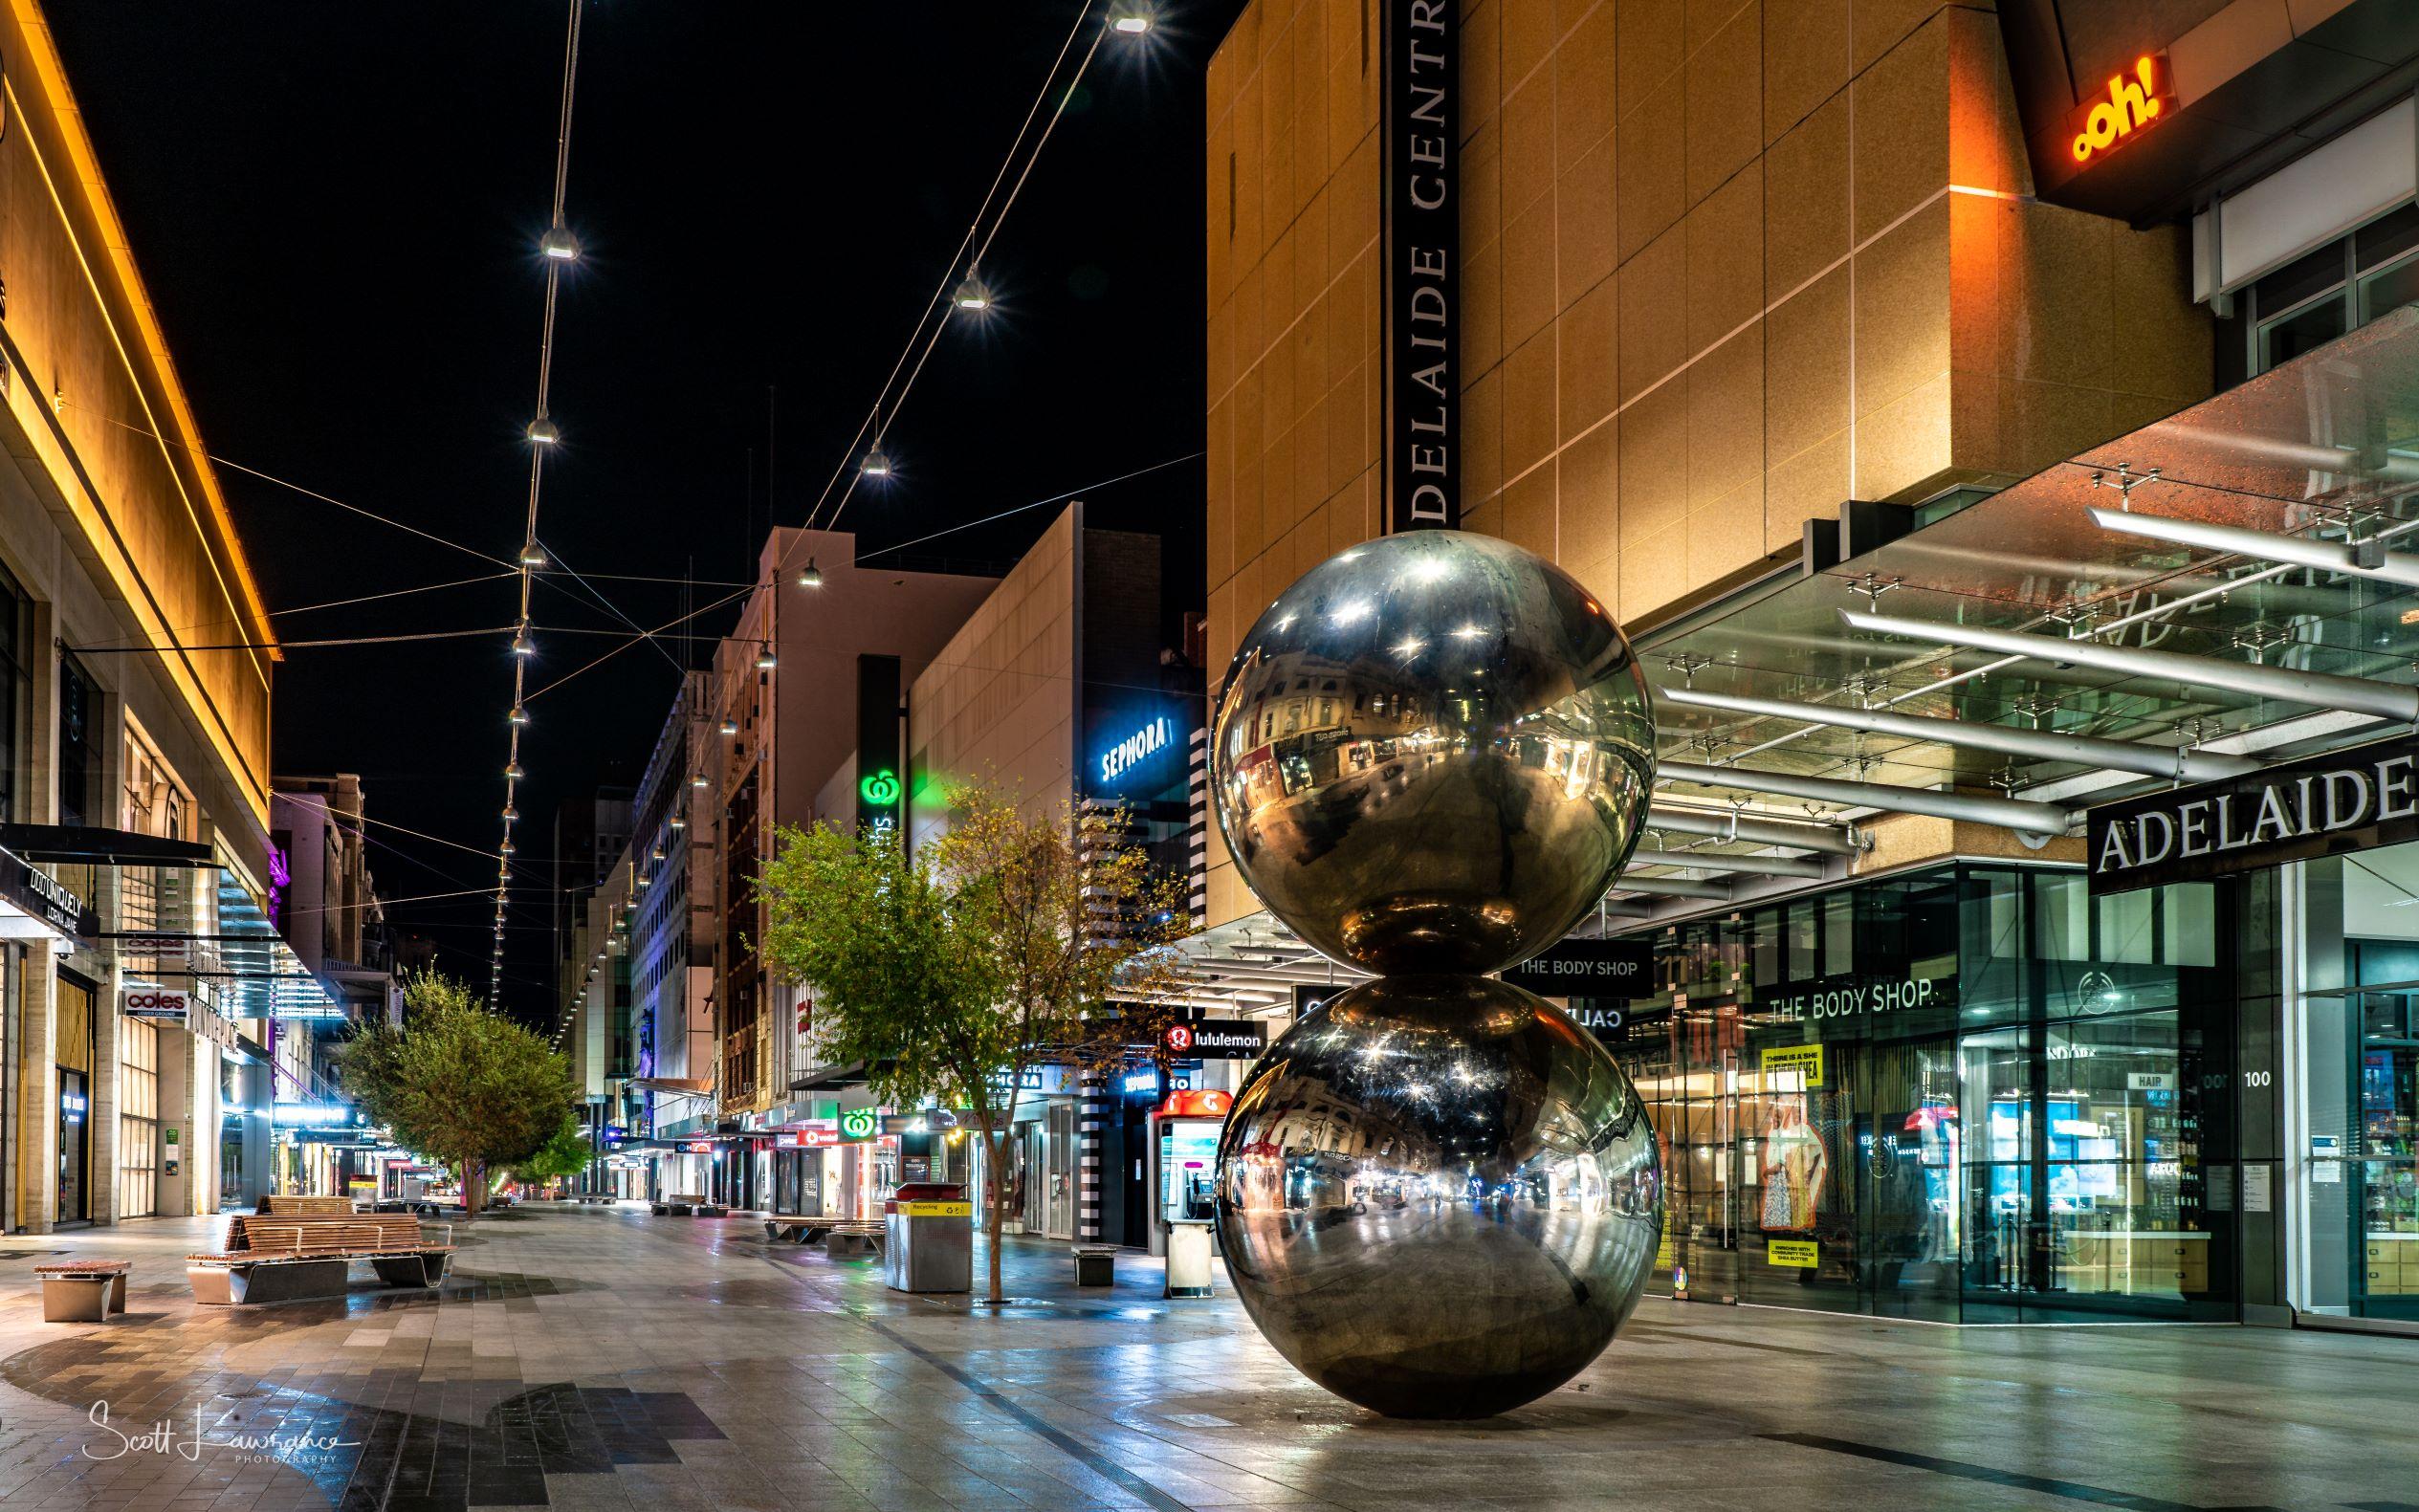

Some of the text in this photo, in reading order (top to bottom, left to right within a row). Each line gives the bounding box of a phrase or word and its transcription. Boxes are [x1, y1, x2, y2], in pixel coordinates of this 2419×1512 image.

[1410, 0, 1446, 524] DELAIDE CENTR
[1102, 716, 1165, 782] SEPHORA
[2096, 755, 2419, 874] ADELAIDE
[1521, 959, 1638, 975] THE BODY SHOP
[127, 992, 185, 1009] coles
[1770, 996, 1805, 1024] THE
[1813, 987, 1866, 1019] BODY
[1196, 1032, 1261, 1047] lululemon
[2139, 1076, 2162, 1087] HAIR
[2245, 1071, 2271, 1087] 100
